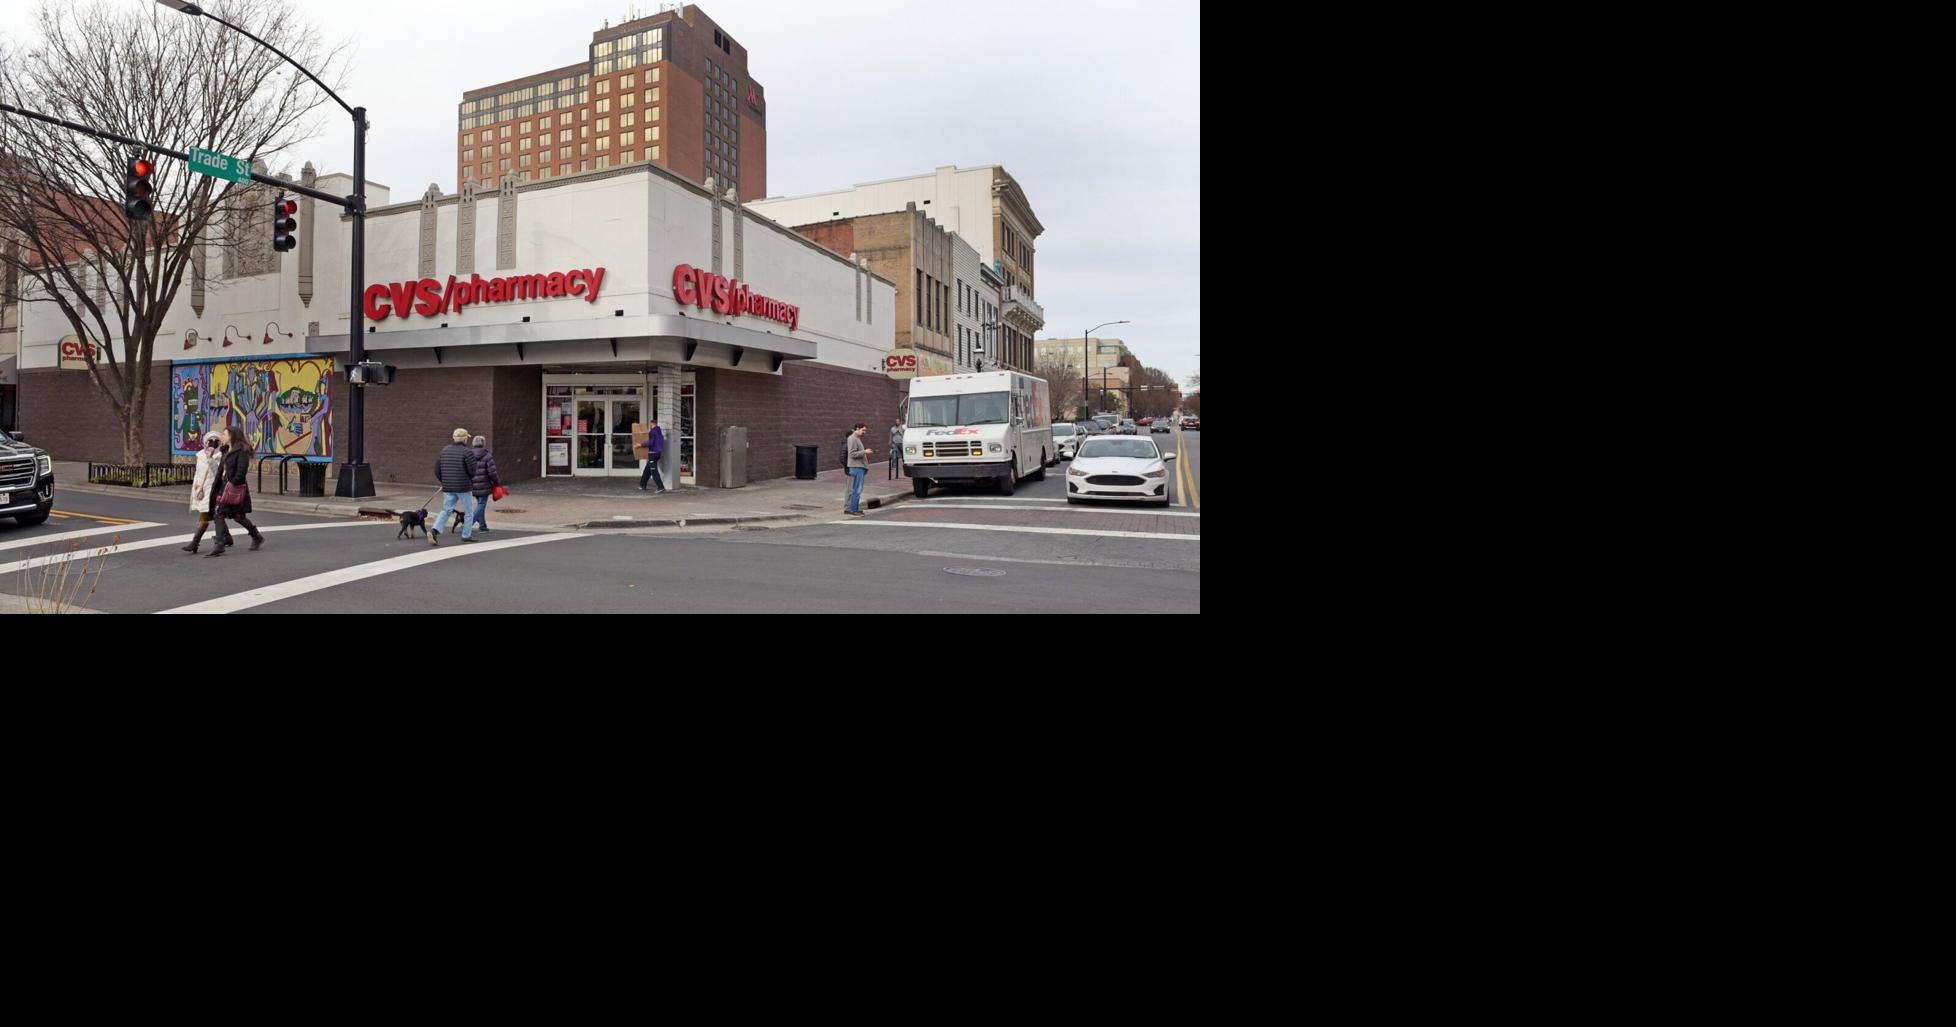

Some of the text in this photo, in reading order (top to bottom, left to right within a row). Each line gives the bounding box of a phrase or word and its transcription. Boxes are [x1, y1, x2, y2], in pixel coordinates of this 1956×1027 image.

[191, 146, 250, 177] Trade St
[364, 267, 605, 321] CVS/pharmacy
[672, 263, 800, 331] CVS/pharmacy
[886, 354, 916, 367] CVS
[926, 427, 980, 436] FedEx
